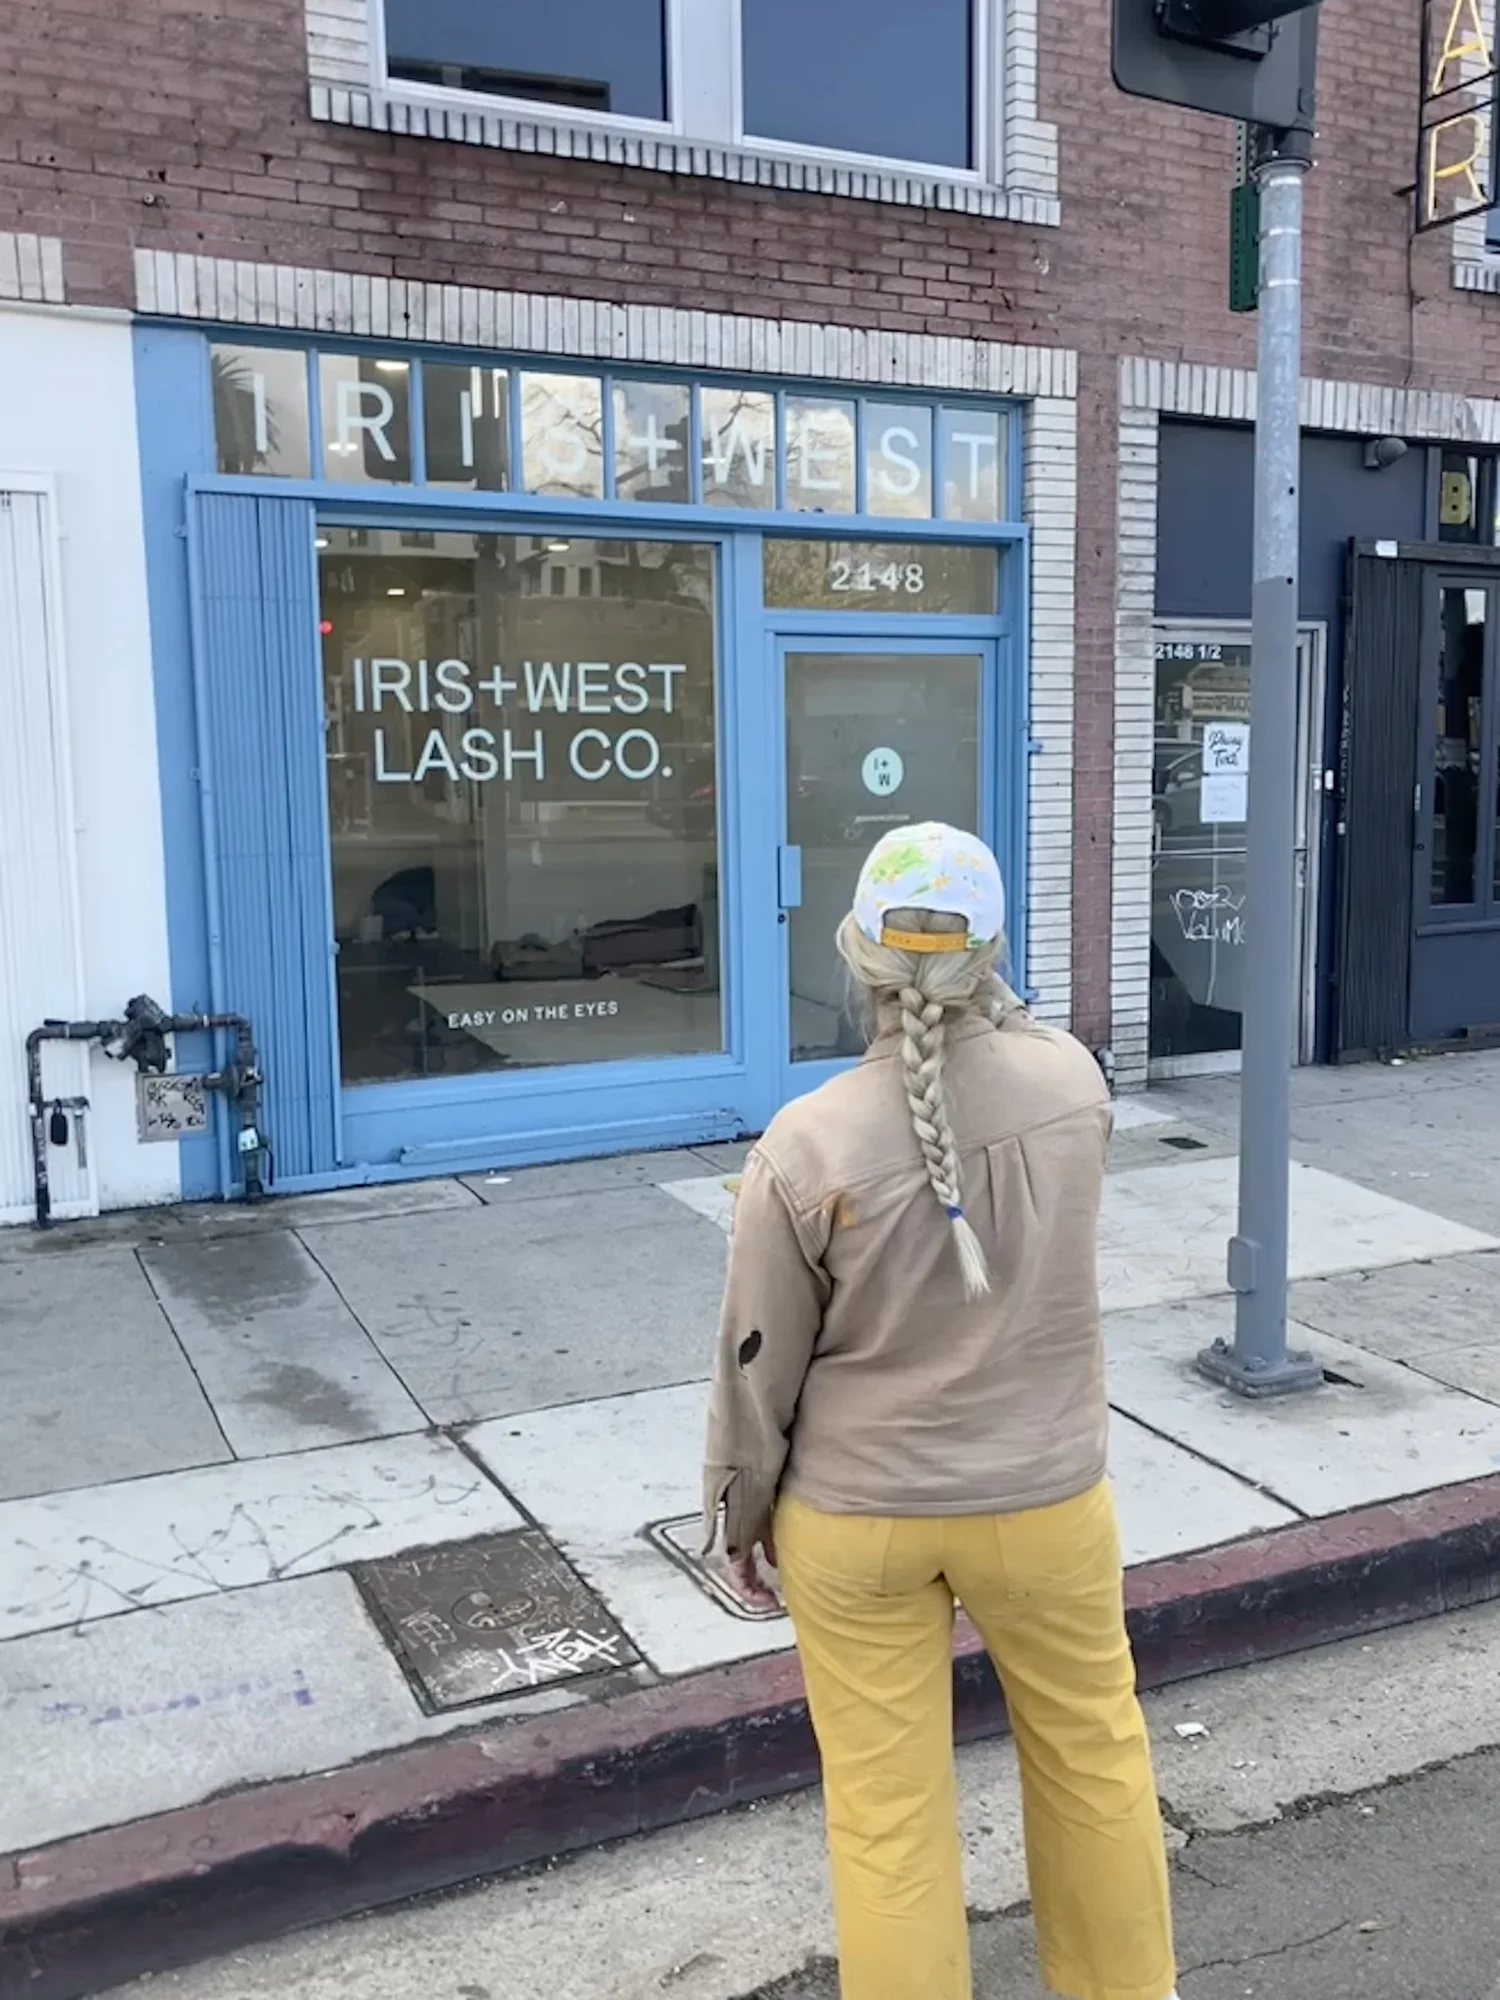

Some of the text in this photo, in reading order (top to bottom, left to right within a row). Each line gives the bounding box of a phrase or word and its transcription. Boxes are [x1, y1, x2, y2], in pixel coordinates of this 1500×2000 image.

[831, 560, 924, 594] 2148
[1155, 643, 1222, 659] 2148 1/2
[353, 657, 687, 713] IRIS+WEST
[375, 728, 674, 781] LASH CO.
[448, 1001, 618, 1029] EASY ON THE EYES
